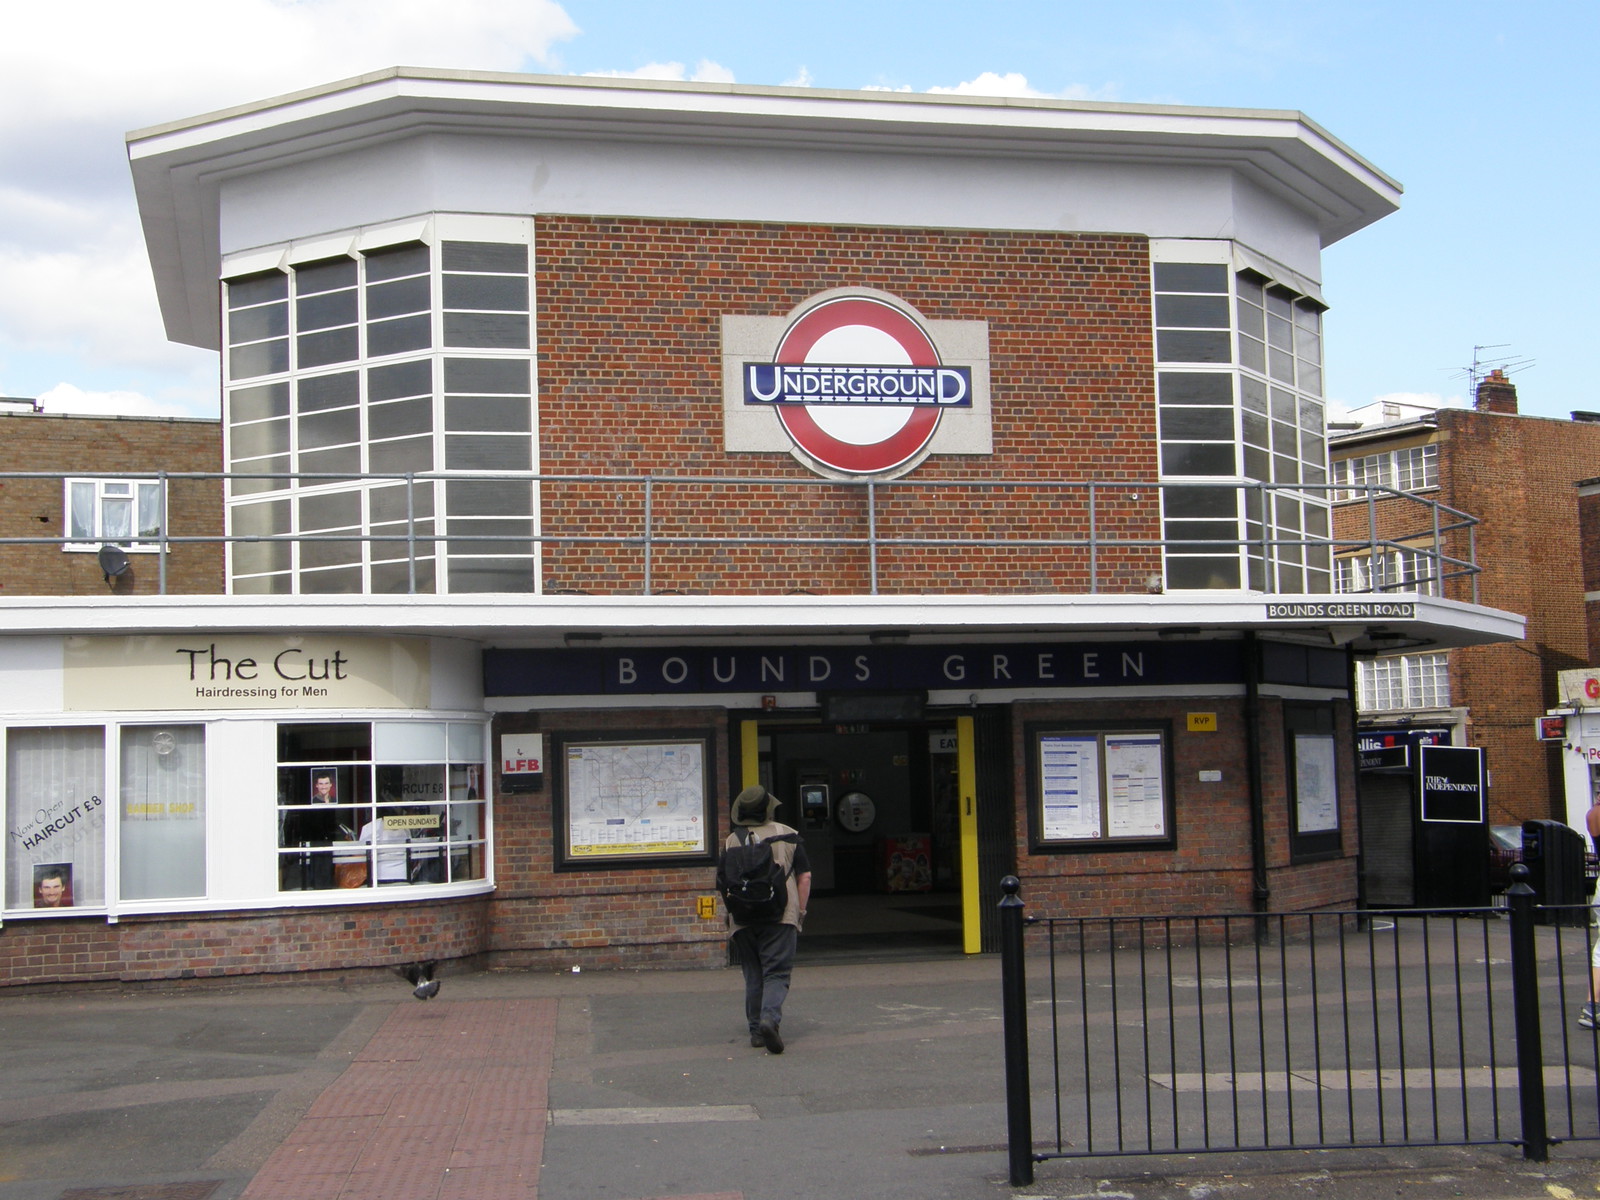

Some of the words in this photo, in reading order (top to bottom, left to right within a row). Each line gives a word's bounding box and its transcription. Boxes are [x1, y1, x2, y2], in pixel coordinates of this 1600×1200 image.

[750, 365, 966, 404] UNDERGROUND
[1269, 604, 1324, 617] BOUNDS
[1327, 604, 1370, 617] GREEN
[1374, 603, 1411, 616] ROAD
[176, 643, 258, 681] The
[274, 648, 348, 681] Cut
[618, 655, 870, 684] BOUNDS
[943, 652, 1143, 681] GREEN
[196, 686, 277, 699] Hairdressing
[281, 686, 299, 697] for
[302, 686, 328, 697] Men
[1194, 717, 1210, 725] RVP
[505, 759, 540, 772] LFB
[1425, 776, 1441, 784] THE
[384, 783, 430, 794] HIRCUT
[1425, 783, 1478, 792] INDEPENDENT
[169, 803, 195, 813] SHOP
[10, 822, 34, 843] Now
[35, 800, 64, 826] Open
[387, 819, 407, 827] OPEN
[408, 817, 437, 826] SUNDAYS
[22, 807, 82, 850] HAIRCUT
